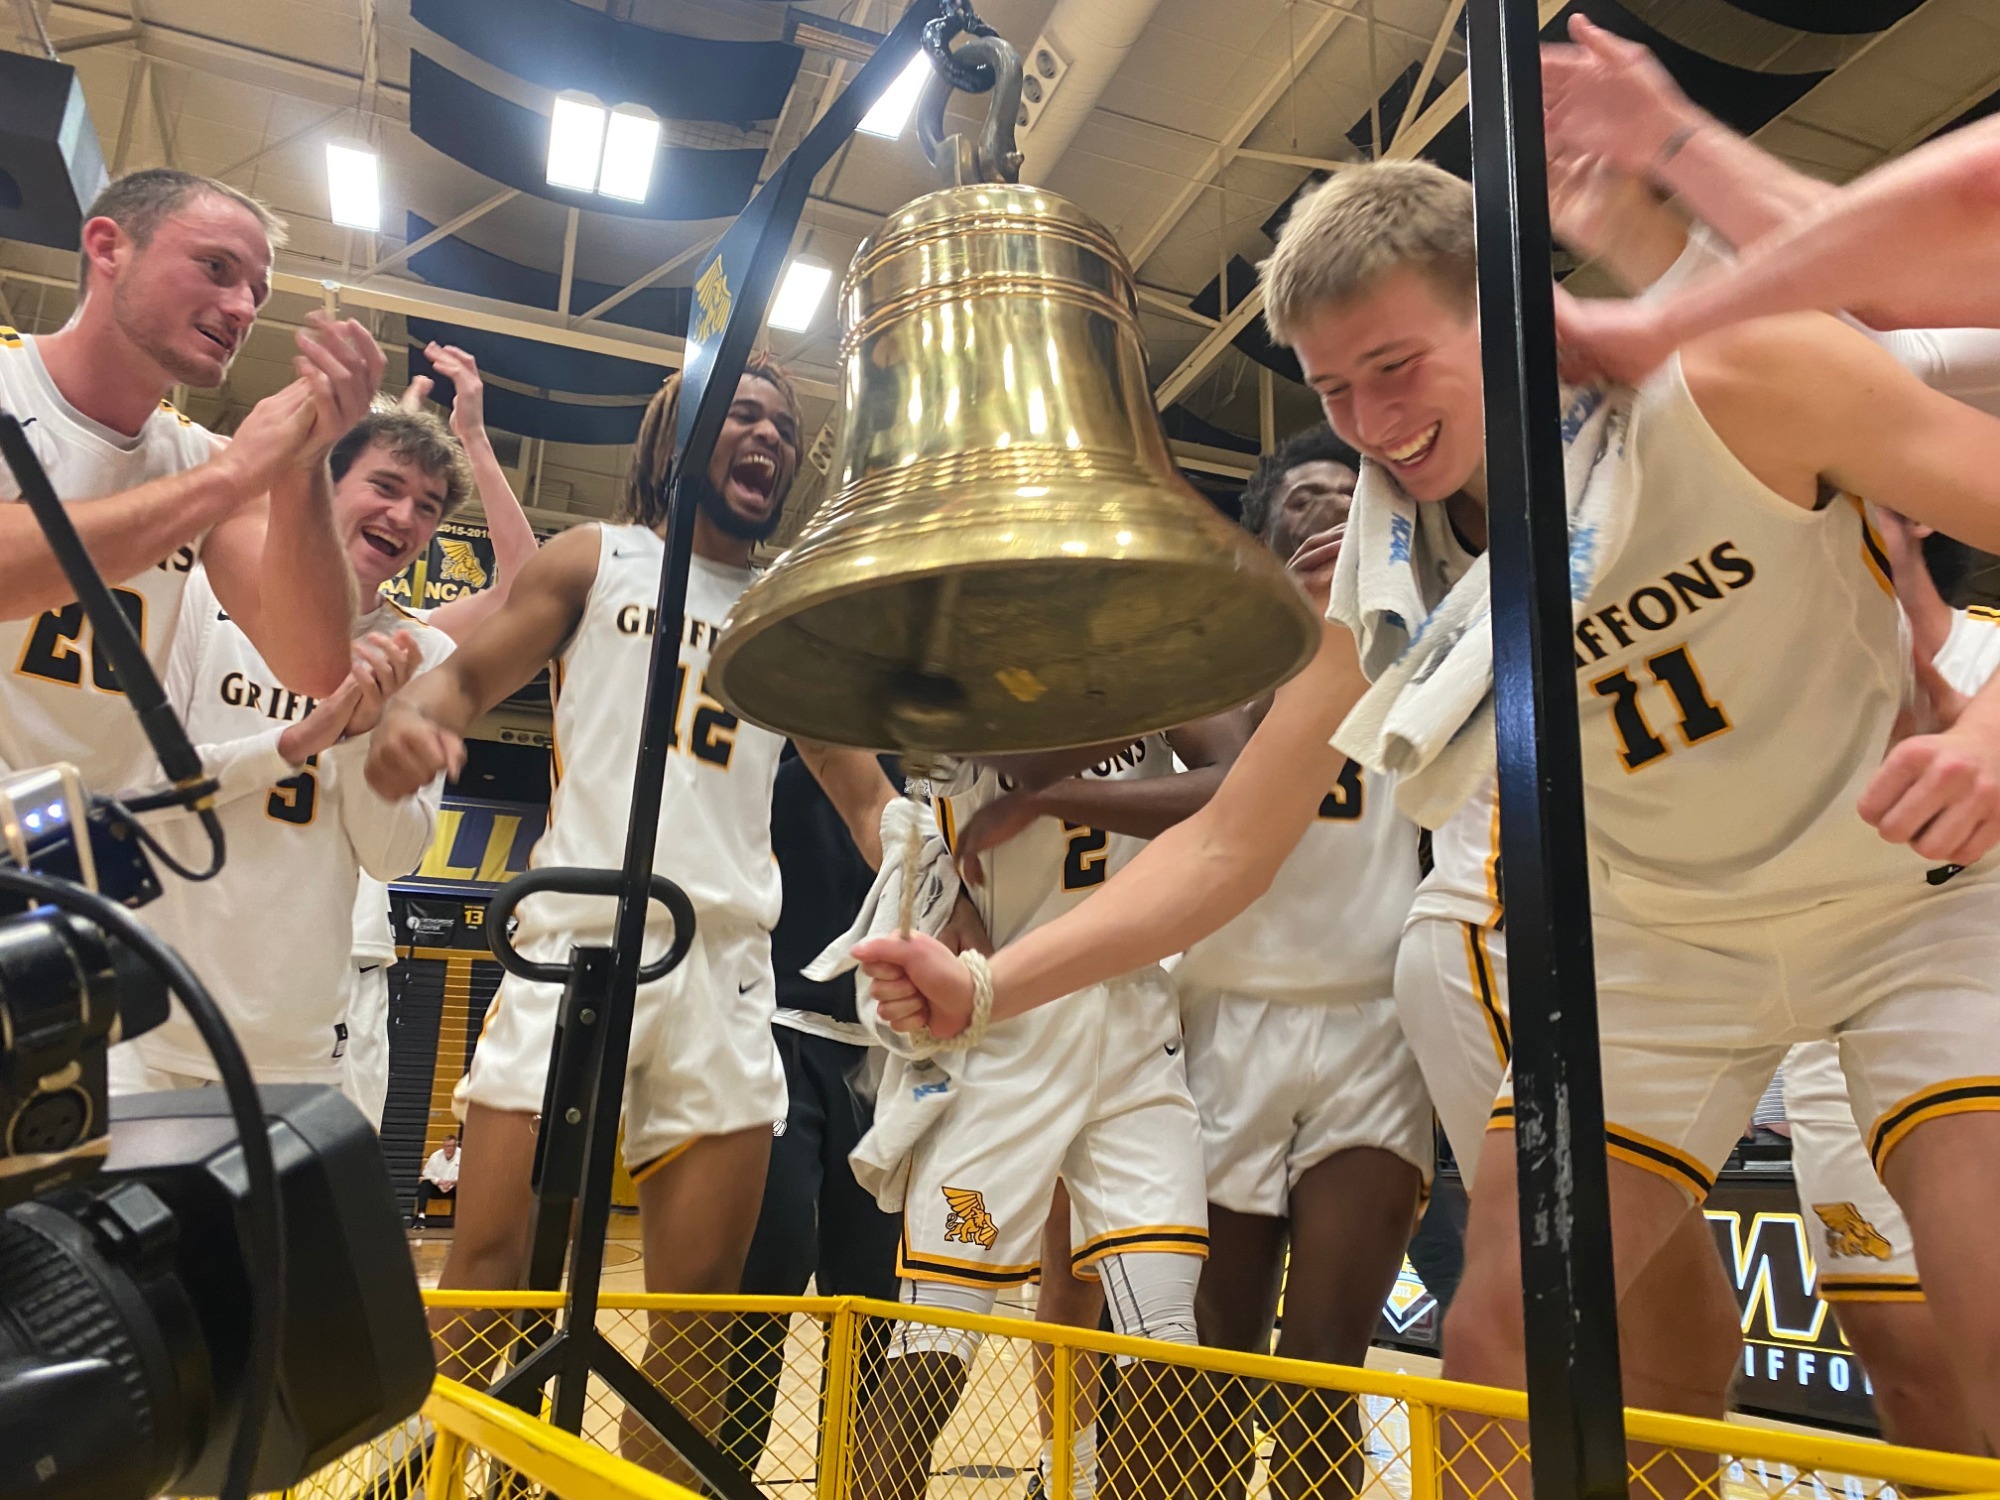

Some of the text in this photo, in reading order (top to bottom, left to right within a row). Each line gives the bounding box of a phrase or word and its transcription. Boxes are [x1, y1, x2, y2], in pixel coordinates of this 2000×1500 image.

[436, 523, 491, 539] 2015-201
[424, 581, 486, 601] NCA
[1575, 540, 1756, 669] FFONS
[219, 671, 325, 722] GRIFF
[1588, 641, 1733, 775] 11
[1060, 819, 1109, 893] 2
[464, 910, 484, 925] 13
[1744, 1344, 1874, 1396] IFFO
